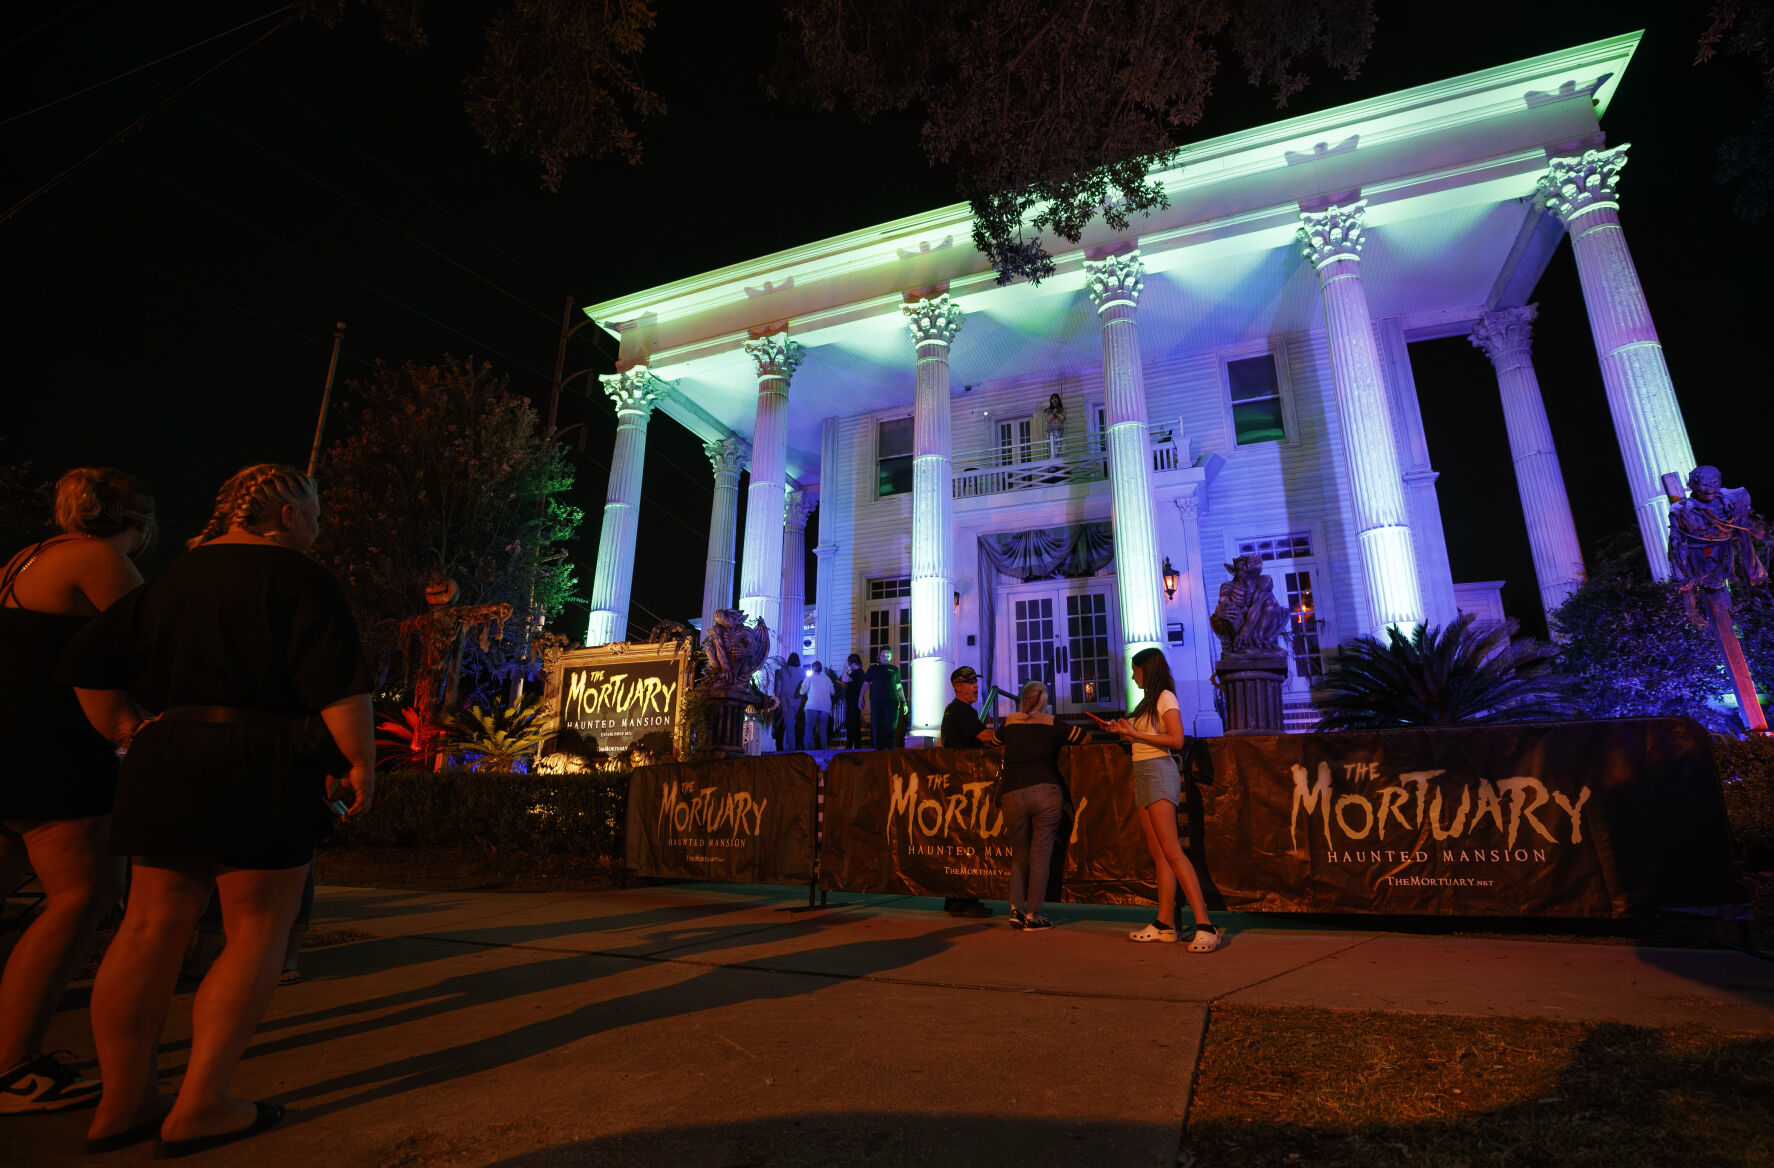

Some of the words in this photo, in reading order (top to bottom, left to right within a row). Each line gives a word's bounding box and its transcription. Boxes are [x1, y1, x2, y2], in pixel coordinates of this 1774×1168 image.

[590, 670, 605, 682] THE
[565, 669, 677, 721] MORTUARY
[567, 719, 615, 731] HAUNTED
[621, 716, 671, 728] MANSION
[1343, 762, 1380, 782] THE
[681, 781, 695, 795] THE
[926, 773, 951, 790] THE
[657, 780, 767, 840] MORTUARY
[1290, 760, 1591, 854] MORTUARY
[668, 838, 704, 847] HAUNTED
[708, 838, 746, 848] MANSION
[908, 845, 976, 857] HAUNTED
[1328, 851, 1428, 864] HAUNTED
[1443, 849, 1546, 863] MANSION
